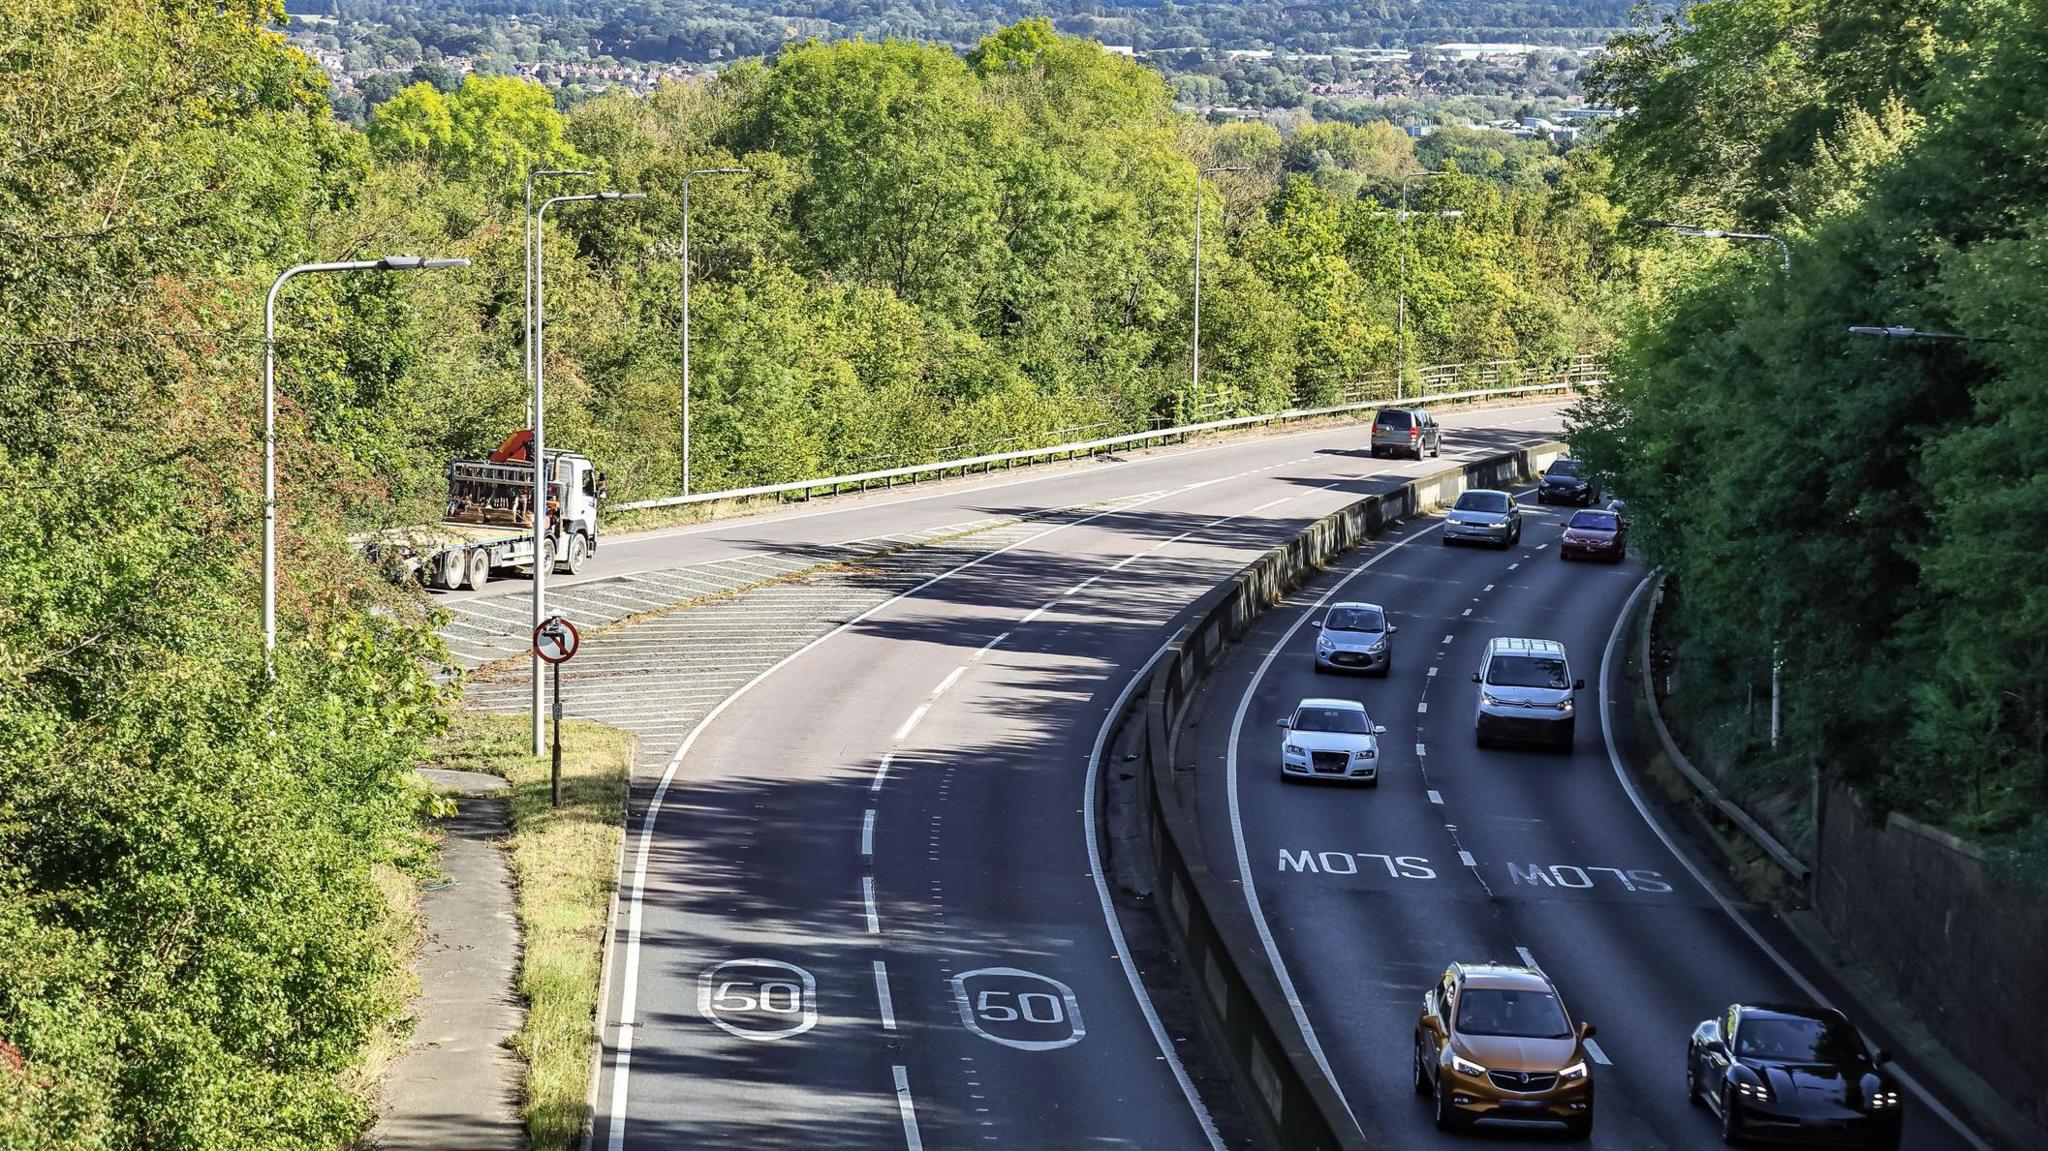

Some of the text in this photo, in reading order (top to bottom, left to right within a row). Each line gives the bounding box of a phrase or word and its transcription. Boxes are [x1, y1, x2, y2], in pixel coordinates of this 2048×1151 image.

[1279, 848, 1436, 879] SLOW
[1507, 861, 1673, 892] SLOW
[713, 981, 801, 1014] 50
[977, 990, 1064, 1024] 50
